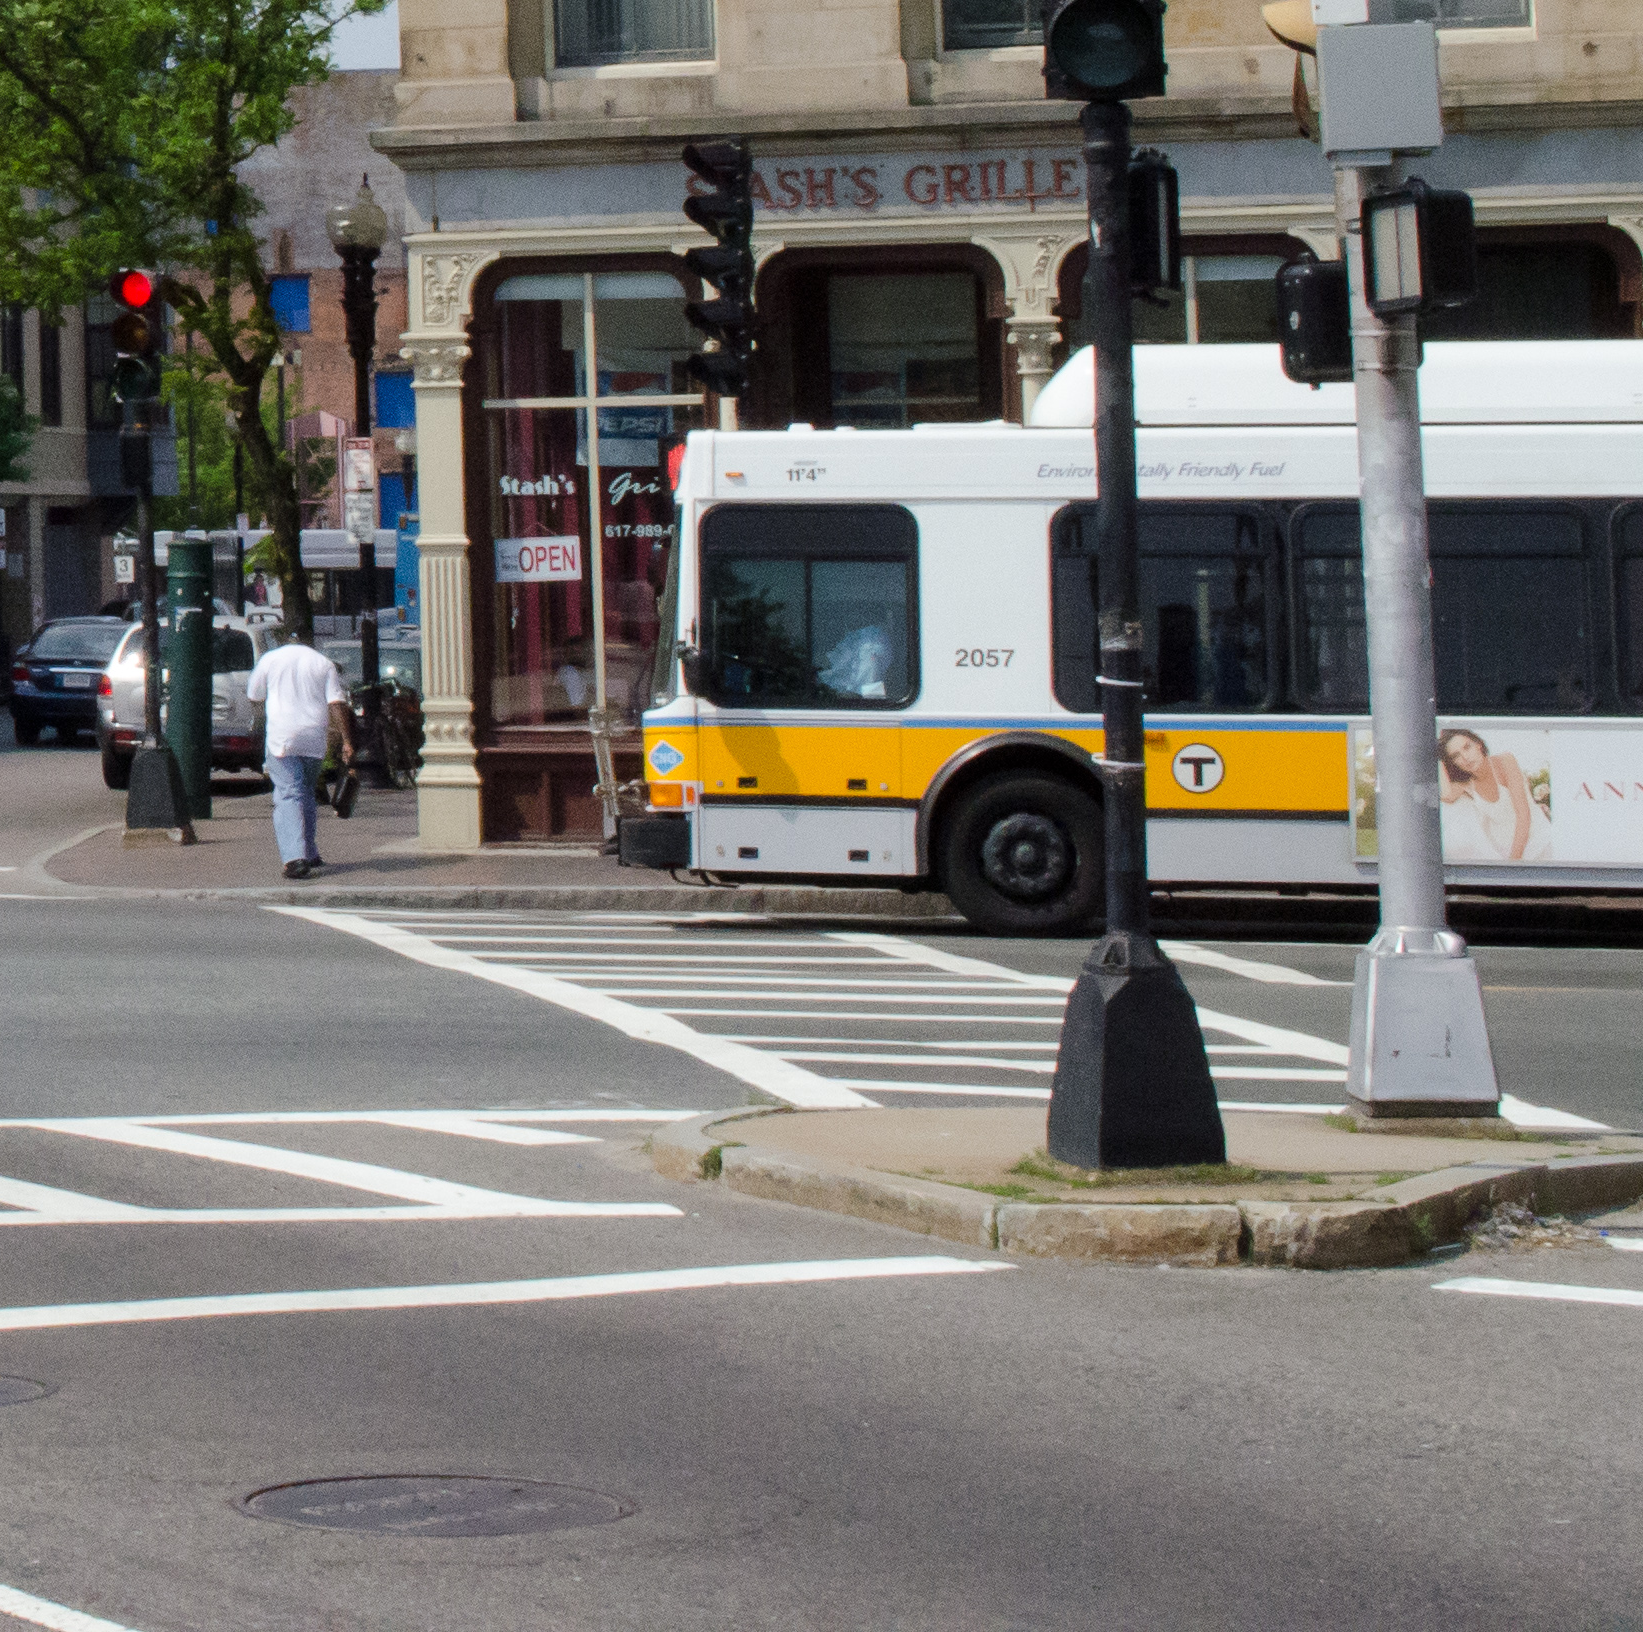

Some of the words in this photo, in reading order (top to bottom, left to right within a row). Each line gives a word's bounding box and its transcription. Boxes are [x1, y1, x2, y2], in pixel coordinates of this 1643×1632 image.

[686, 165, 881, 210] ASH'S
[904, 158, 1080, 207] GRILLE
[1037, 462, 1172, 481] Environtally
[1178, 461, 1244, 481] Friendly
[1249, 461, 1287, 478] Fuel
[499, 473, 576, 496] Stash's
[119, 558, 128, 573] 3
[519, 545, 576, 573] OPEN
[955, 648, 1015, 667] 2057
[1179, 756, 1216, 787] T
